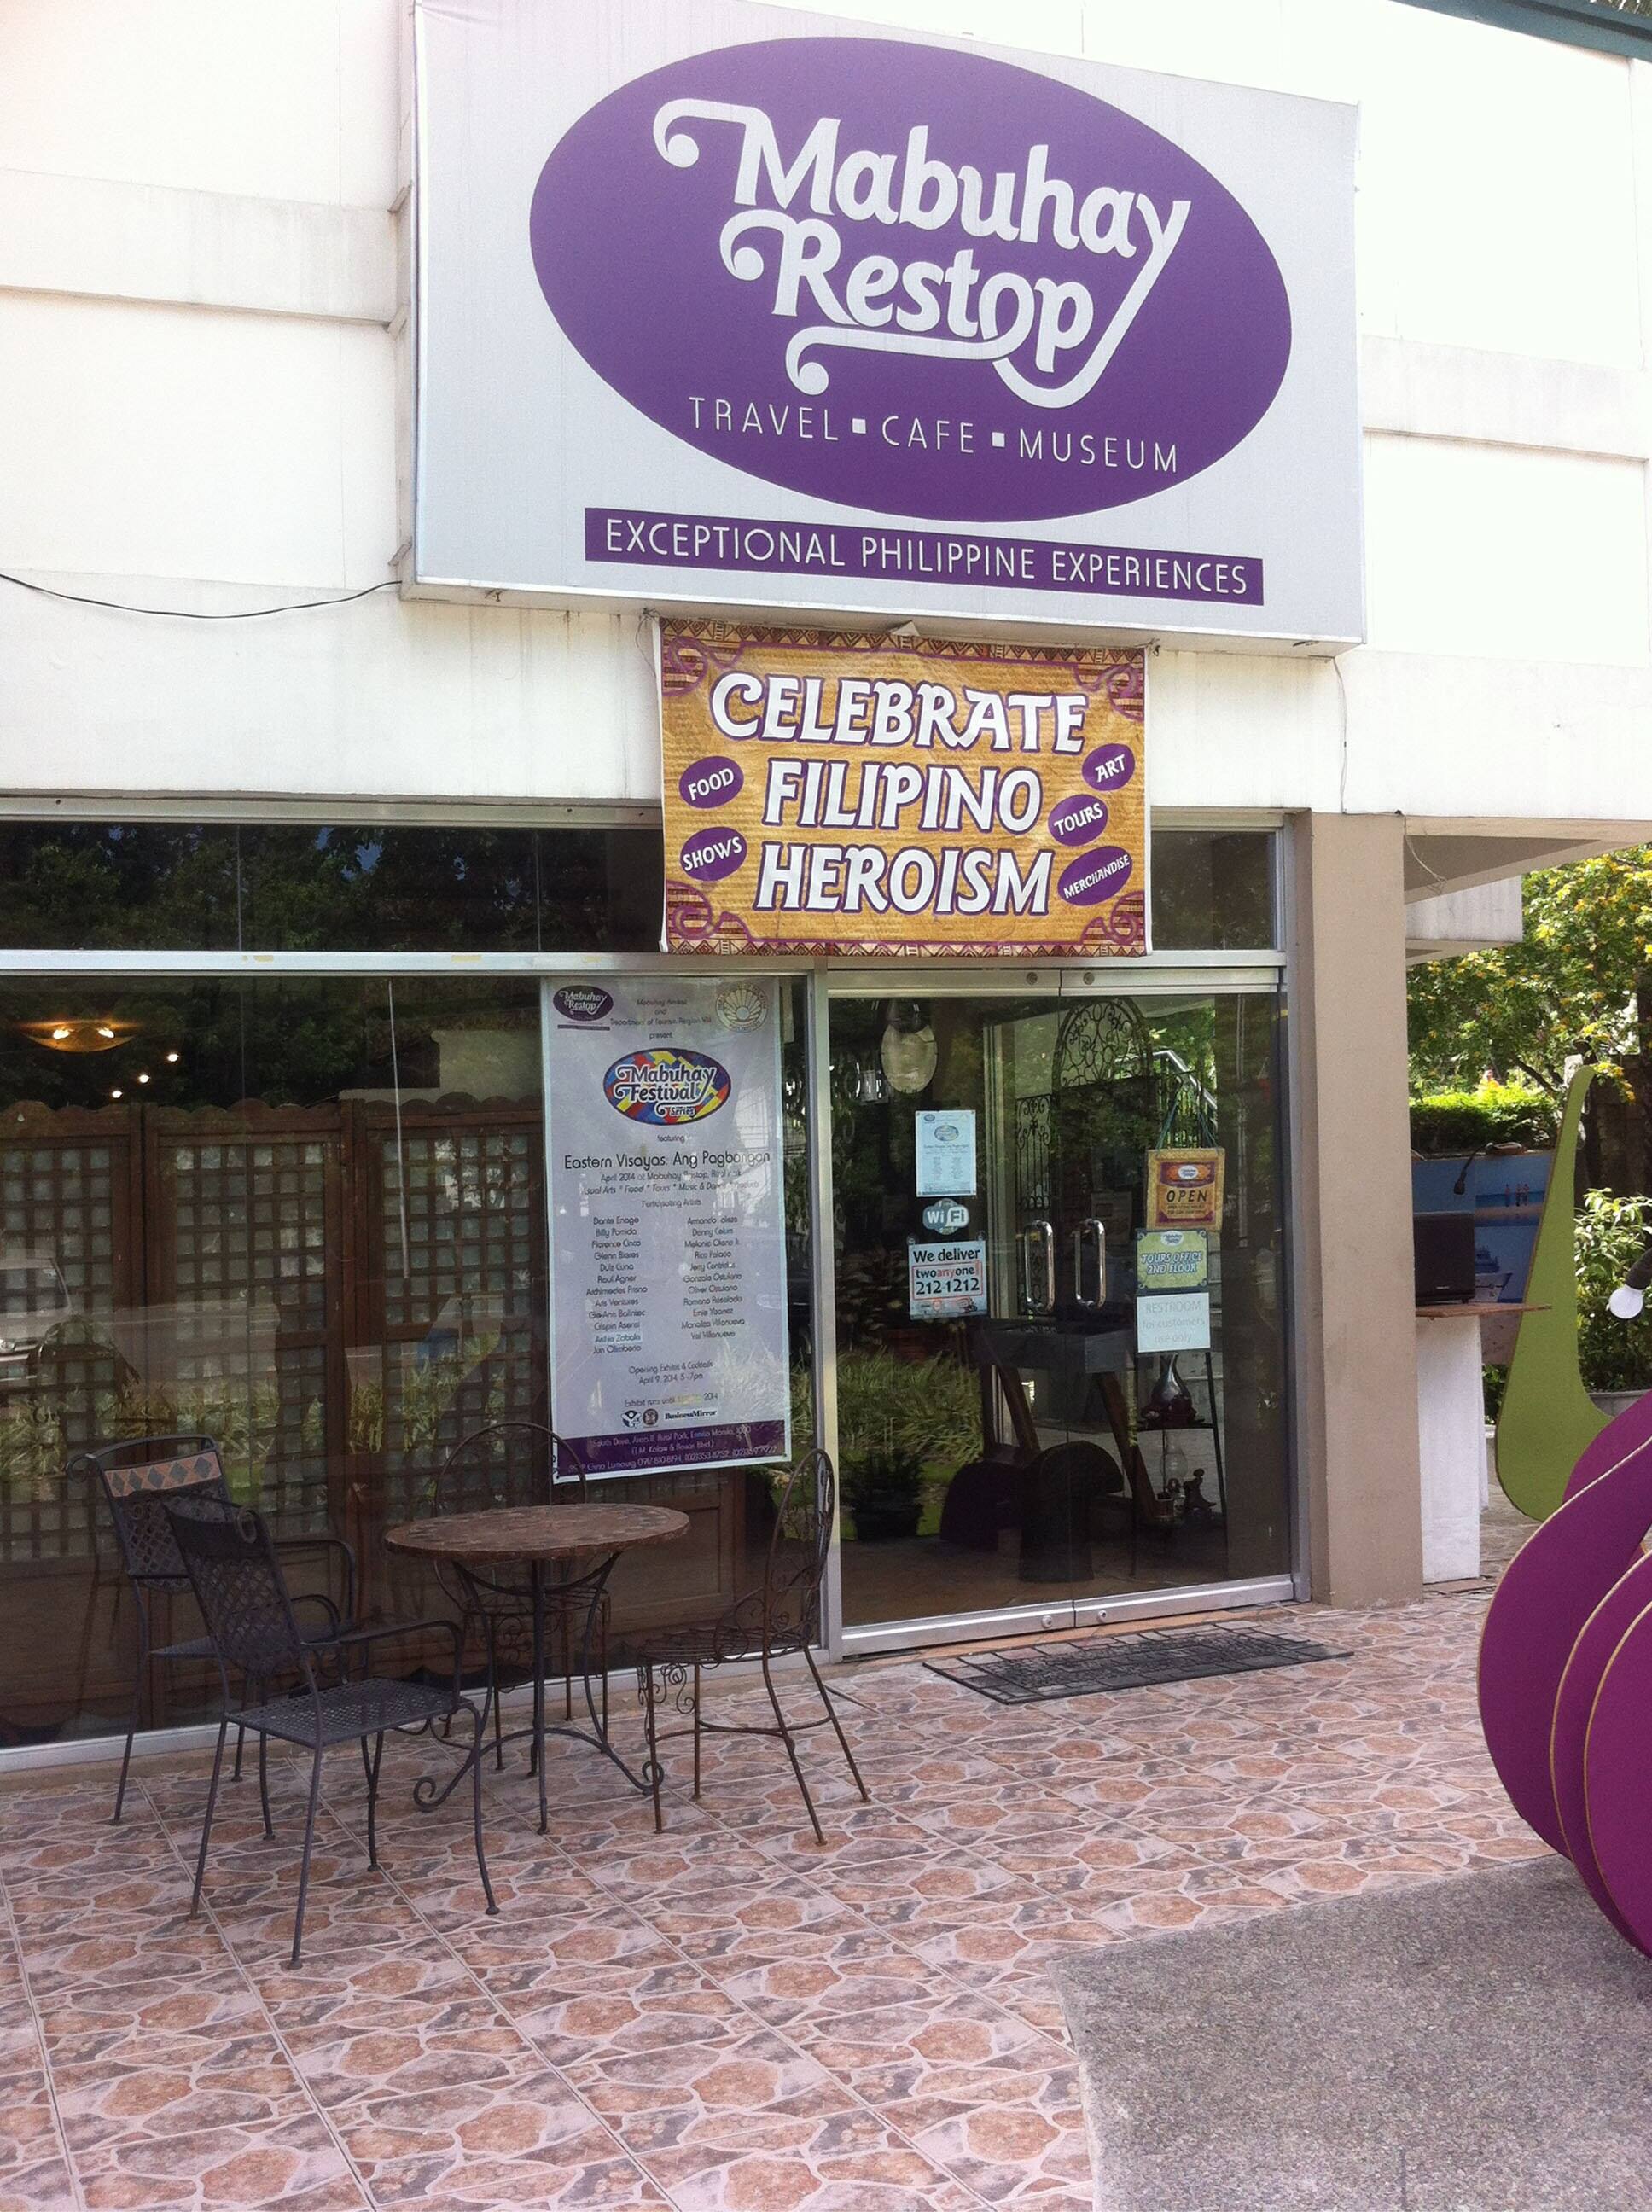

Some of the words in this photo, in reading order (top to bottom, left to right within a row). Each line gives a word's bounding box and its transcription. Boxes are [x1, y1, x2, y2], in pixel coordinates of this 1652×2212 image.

[720, 210, 1094, 395] Restop
[689, 397, 840, 443] TRAVEL
[881, 416, 974, 453] CAFE
[1020, 429, 1178, 473] MUSEUM
[607, 519, 845, 568] EXCEPTIONAL
[863, 537, 1034, 579] PHILIPPINE
[1052, 552, 1247, 595] EXPERIENCES
[711, 673, 1087, 753] CELEBRATE
[688, 769, 735, 800] FOOD
[1095, 754, 1126, 783] ART
[765, 760, 1042, 833] FILIPINO
[1054, 803, 1103, 836] TOURS
[683, 837, 742, 871] SHOWS
[755, 842, 1054, 914] HEROISM
[1063, 854, 1131, 899] MERCHANDISE
[614, 1082, 696, 1102] Festival
[671, 1107, 695, 1115] Series
[565, 1155, 612, 1169] Eastern
[673, 1152, 698, 1169] Ang
[1166, 1190, 1207, 1202] OPEN
[913, 1250, 935, 1263] We
[938, 1248, 980, 1261] deliver
[1141, 1253, 1171, 1264] TOURS
[1146, 1300, 1201, 1313] RESTROOM
